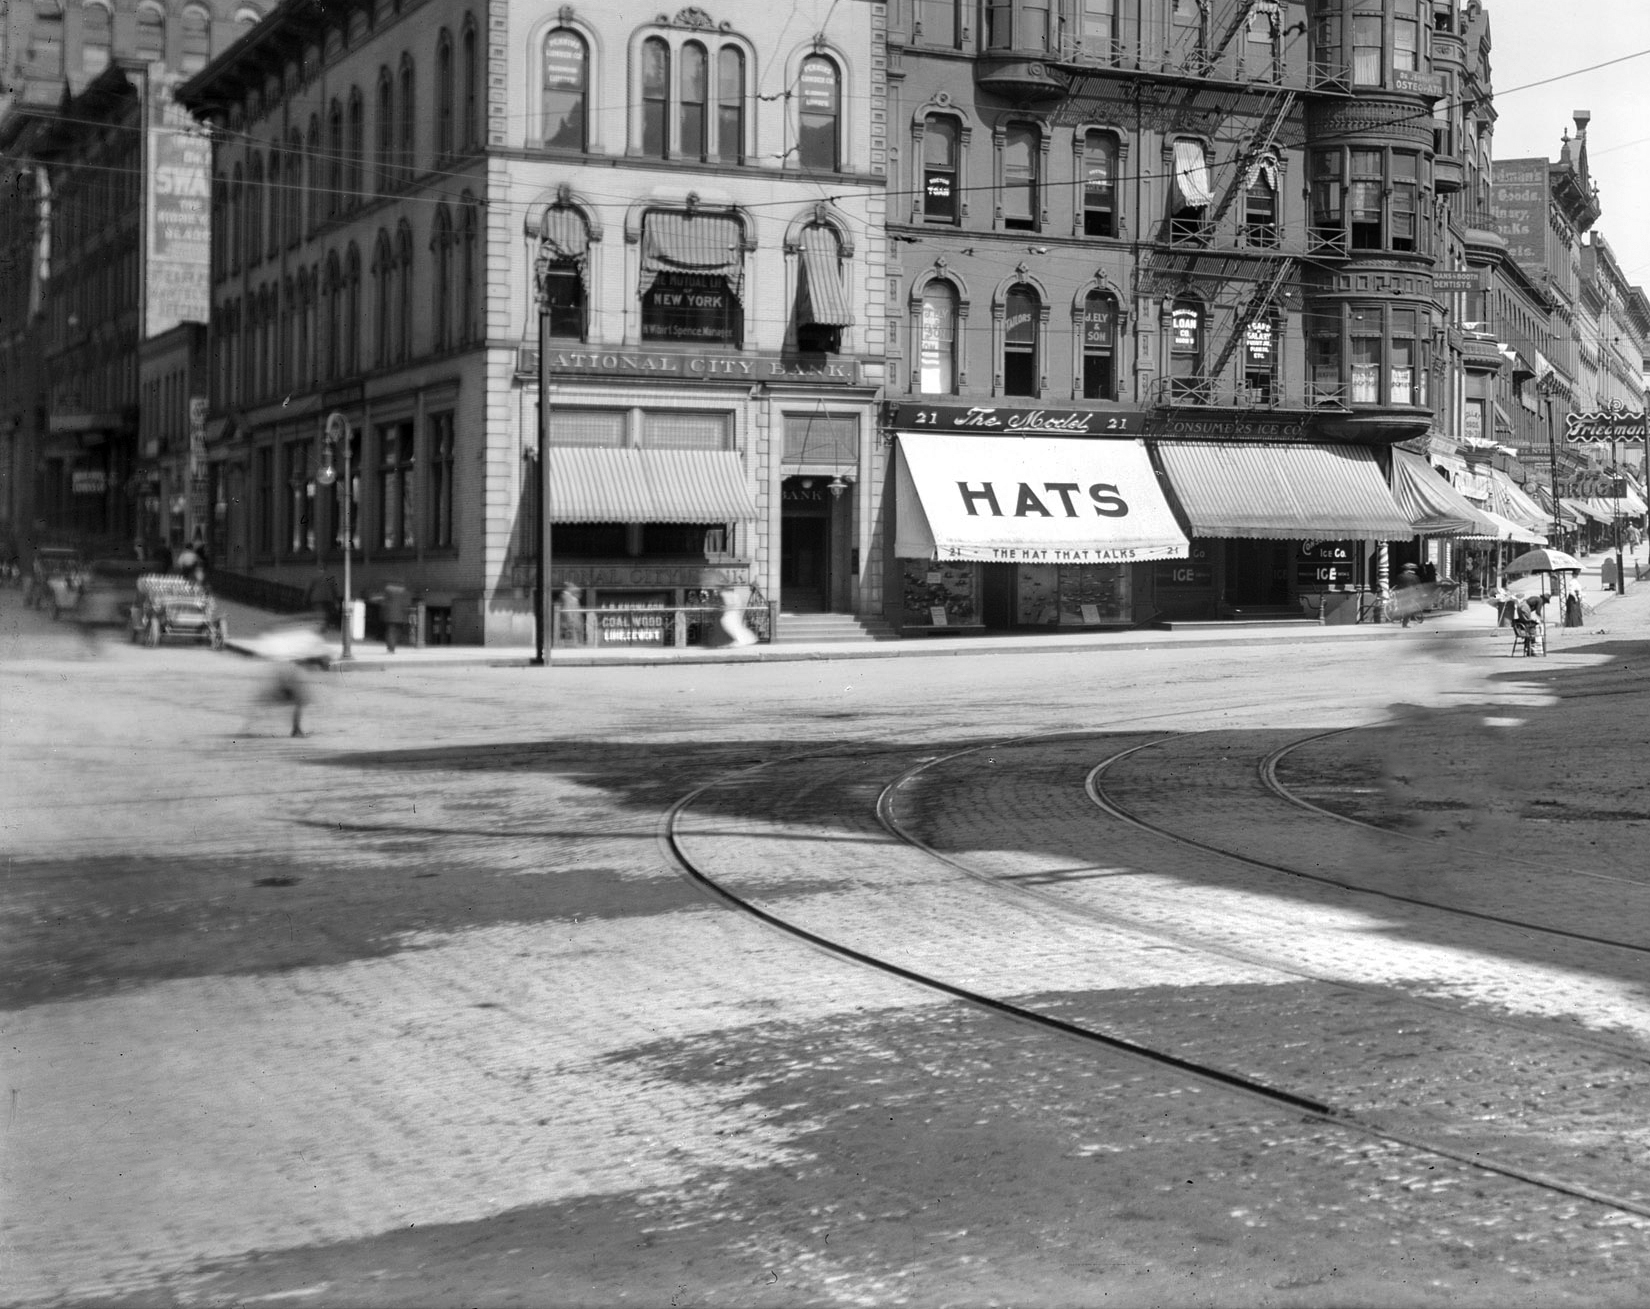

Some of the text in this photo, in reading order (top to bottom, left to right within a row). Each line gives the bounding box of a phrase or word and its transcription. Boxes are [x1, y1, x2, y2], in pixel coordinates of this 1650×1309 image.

[1433, 280, 1472, 288] DENTISTS
[653, 293, 723, 308] NEW YORK
[1005, 313, 1033, 329] TAILORS
[1172, 318, 1197, 329] LOAN
[1087, 331, 1106, 341] SON
[689, 359, 755, 375] CITY
[915, 406, 1128, 431] 21 The Model 21
[1166, 421, 1251, 434] CONSUMERS
[1257, 424, 1280, 435] ICE
[955, 480, 1130, 518] HATS
[949, 546, 1179, 561] 21 THE HAT THAT TALKS 21
[1172, 568, 1195, 582] ICE
[1316, 567, 1337, 581] ICE
[602, 615, 662, 628] COAL WOOD
